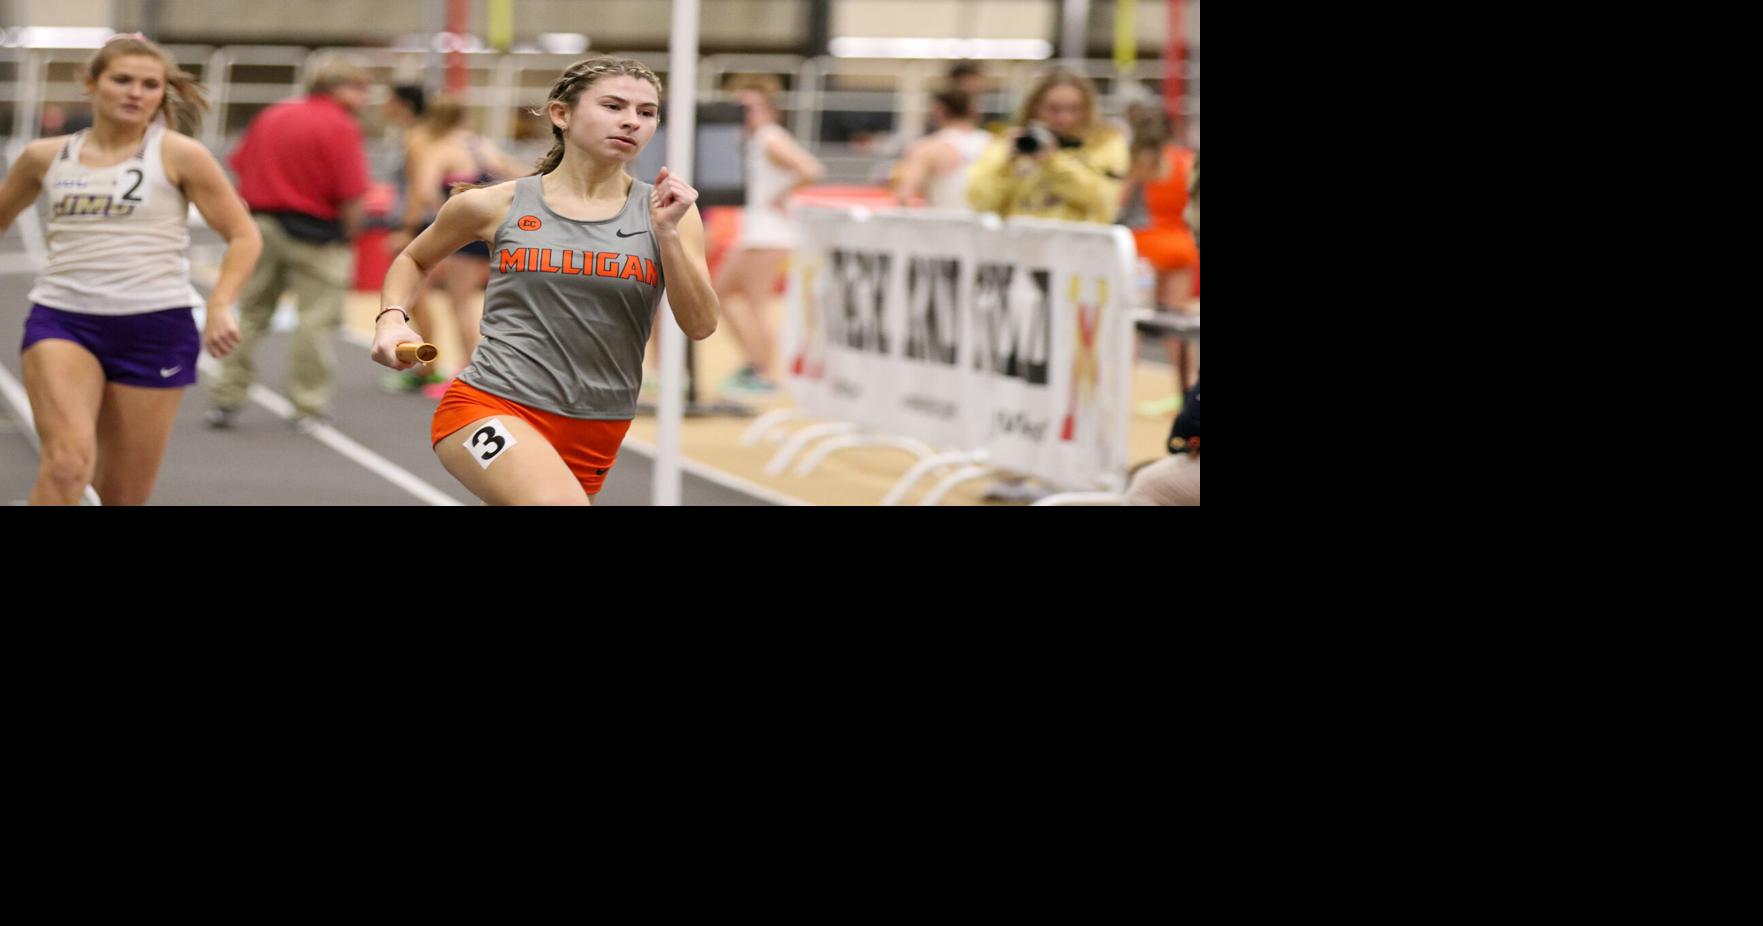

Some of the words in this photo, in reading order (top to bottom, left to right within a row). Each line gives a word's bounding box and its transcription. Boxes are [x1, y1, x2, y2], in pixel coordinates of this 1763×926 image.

[121, 168, 144, 202] 2
[499, 247, 659, 288] MILLIGAN
[471, 425, 506, 460] 3
